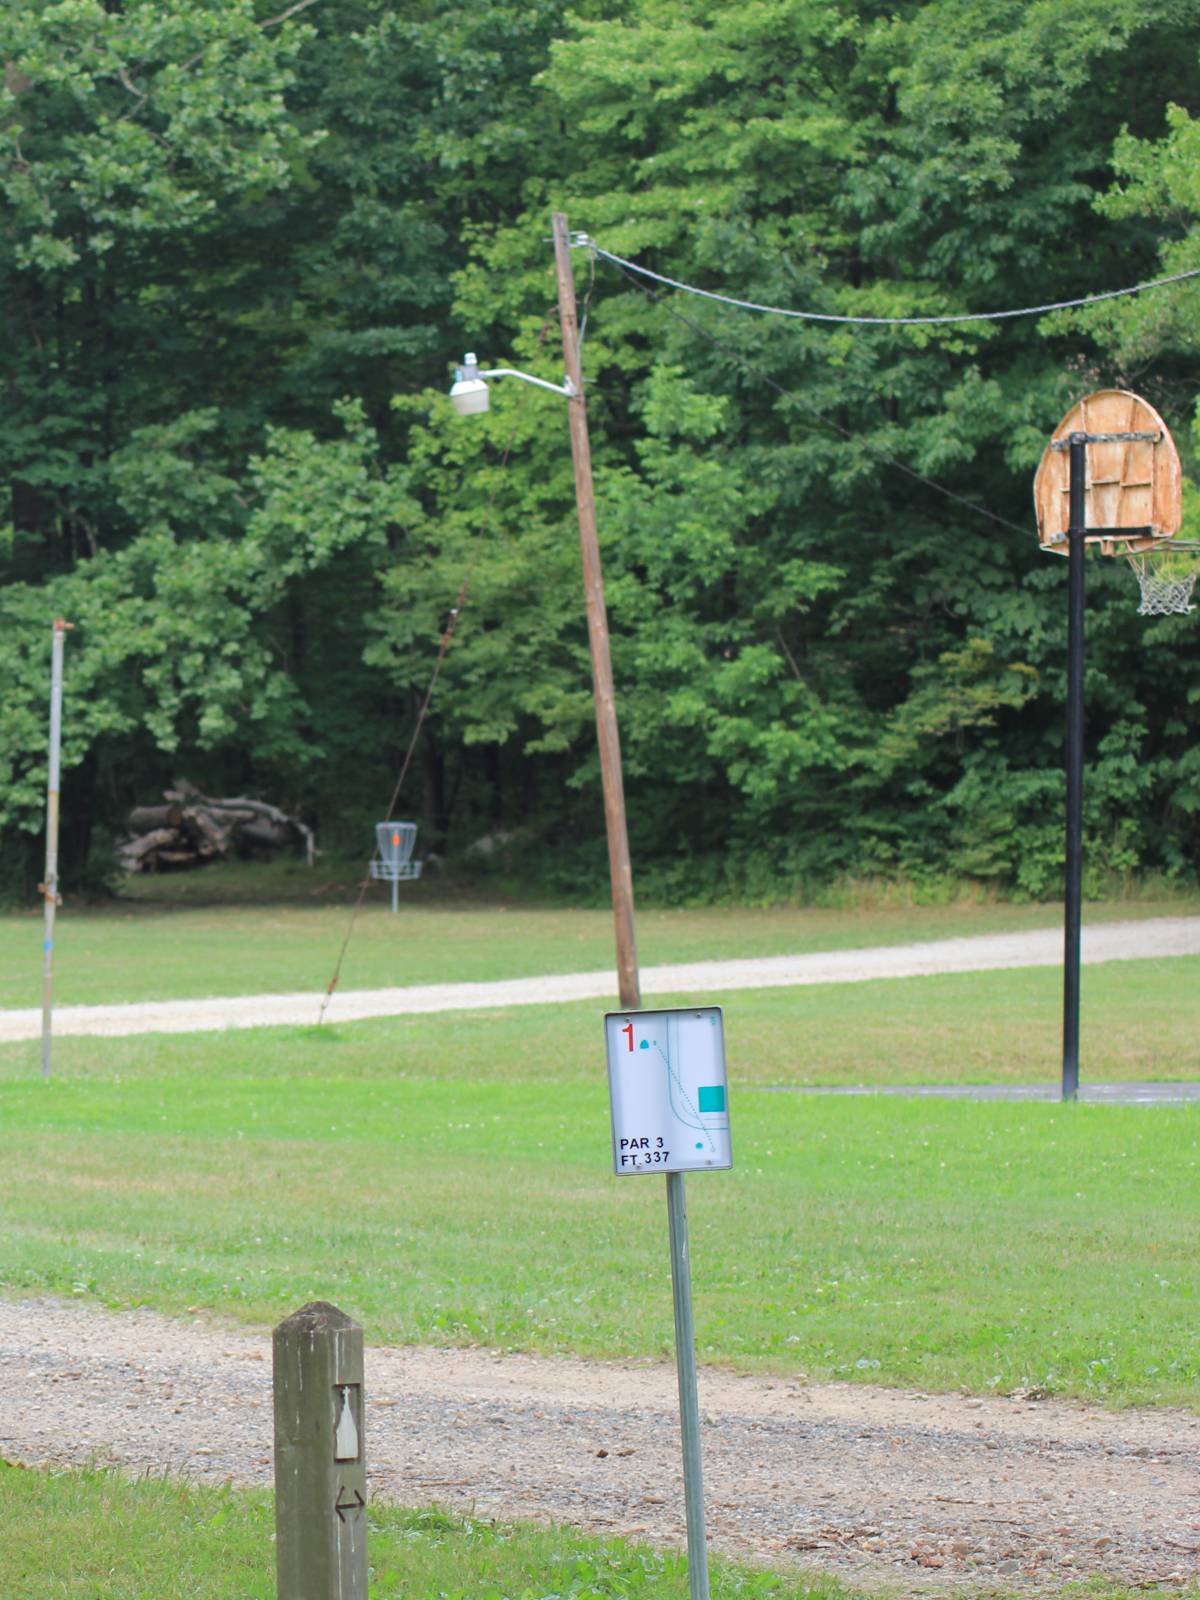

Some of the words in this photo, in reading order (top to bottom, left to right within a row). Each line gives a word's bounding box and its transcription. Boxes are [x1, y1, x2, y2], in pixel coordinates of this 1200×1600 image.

[622, 1023, 634, 1052] 1
[620, 1137, 650, 1150] PAR
[656, 1136, 664, 1148] 3
[644, 1151, 670, 1164] 337
